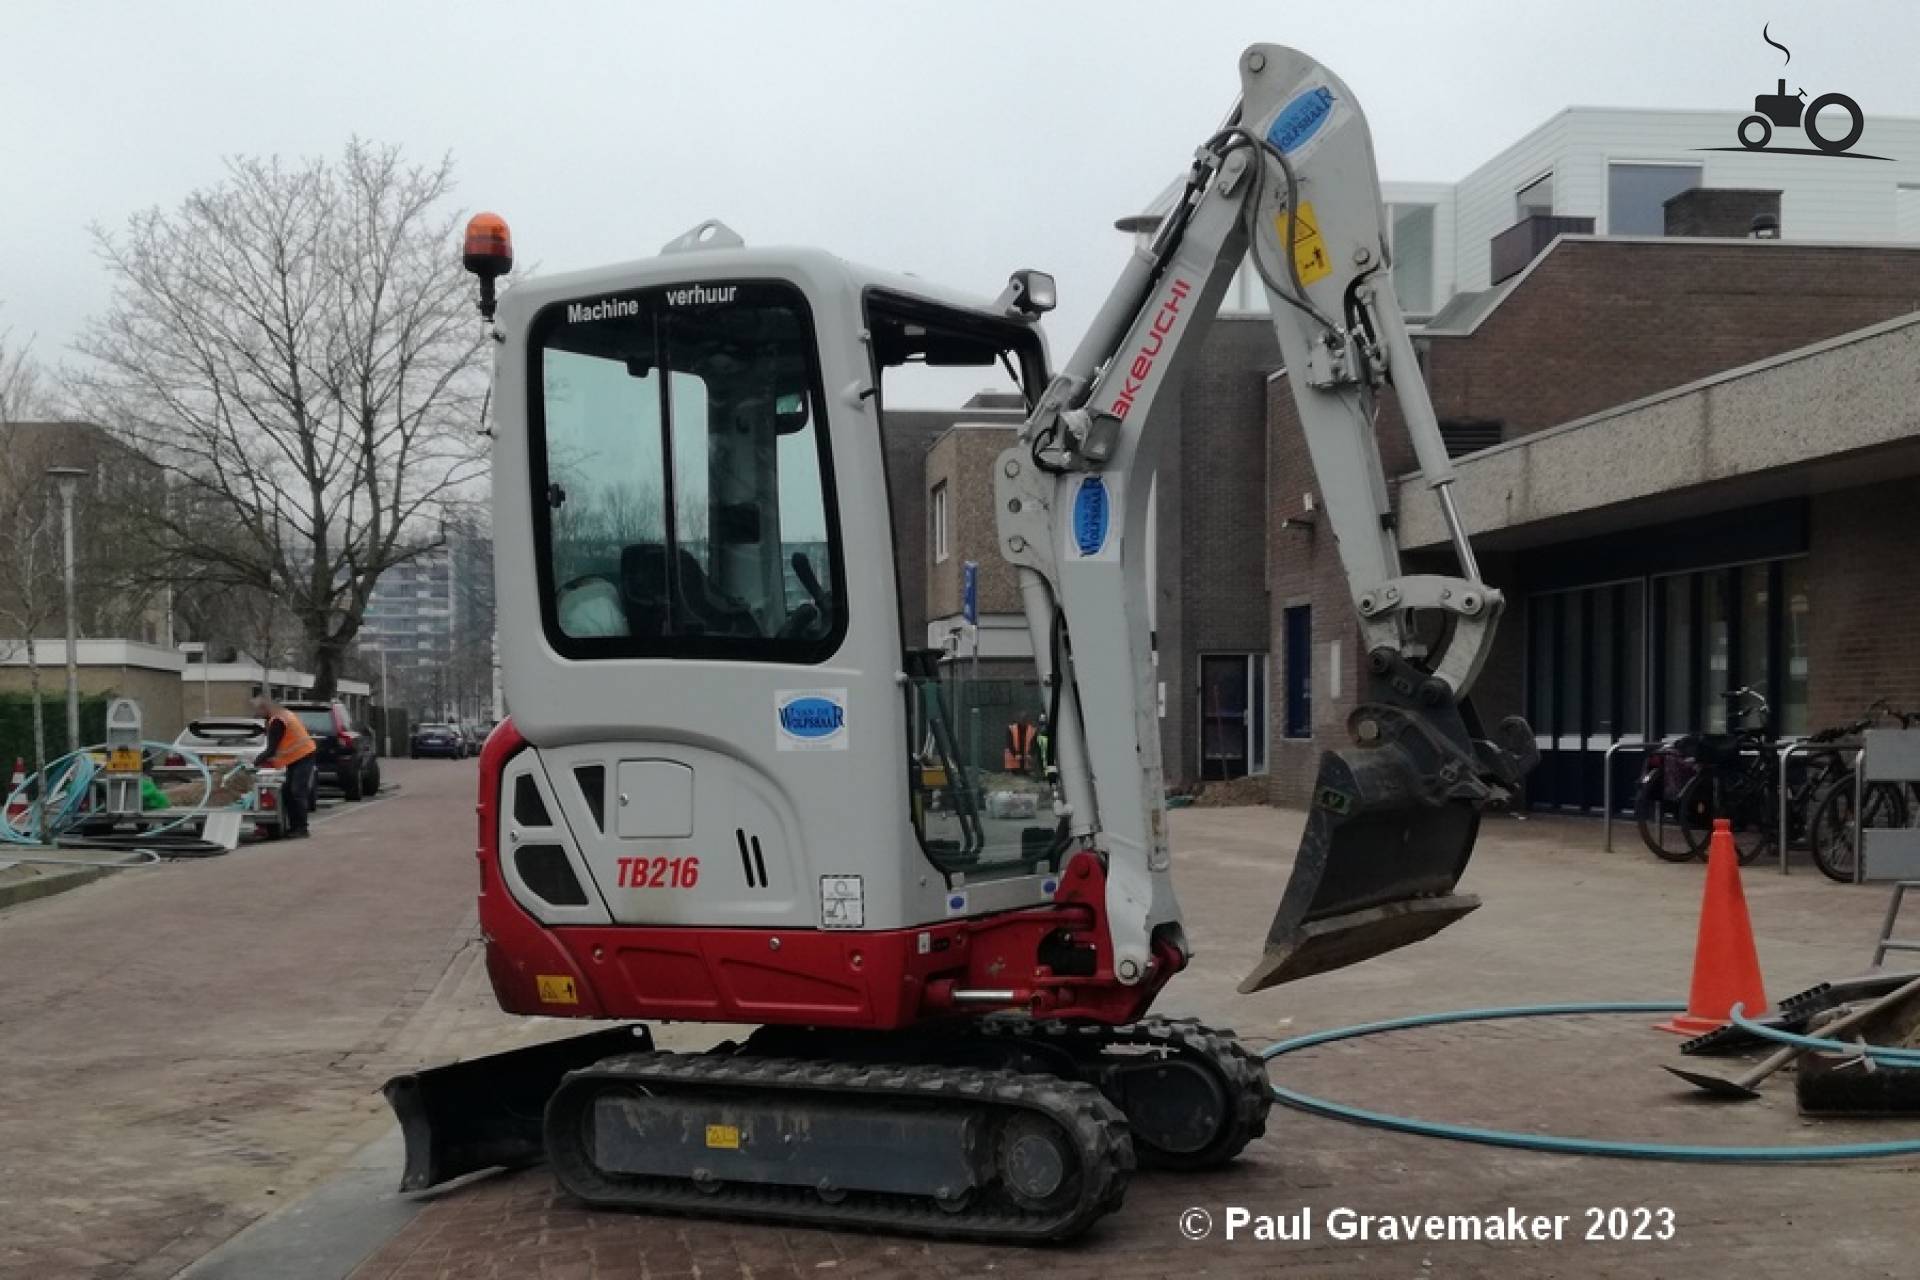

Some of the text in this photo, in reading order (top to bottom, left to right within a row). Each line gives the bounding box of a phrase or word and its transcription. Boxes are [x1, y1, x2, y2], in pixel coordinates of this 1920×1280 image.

[567, 285, 737, 323] Machine verhuur
[616, 857, 700, 888] TB216
